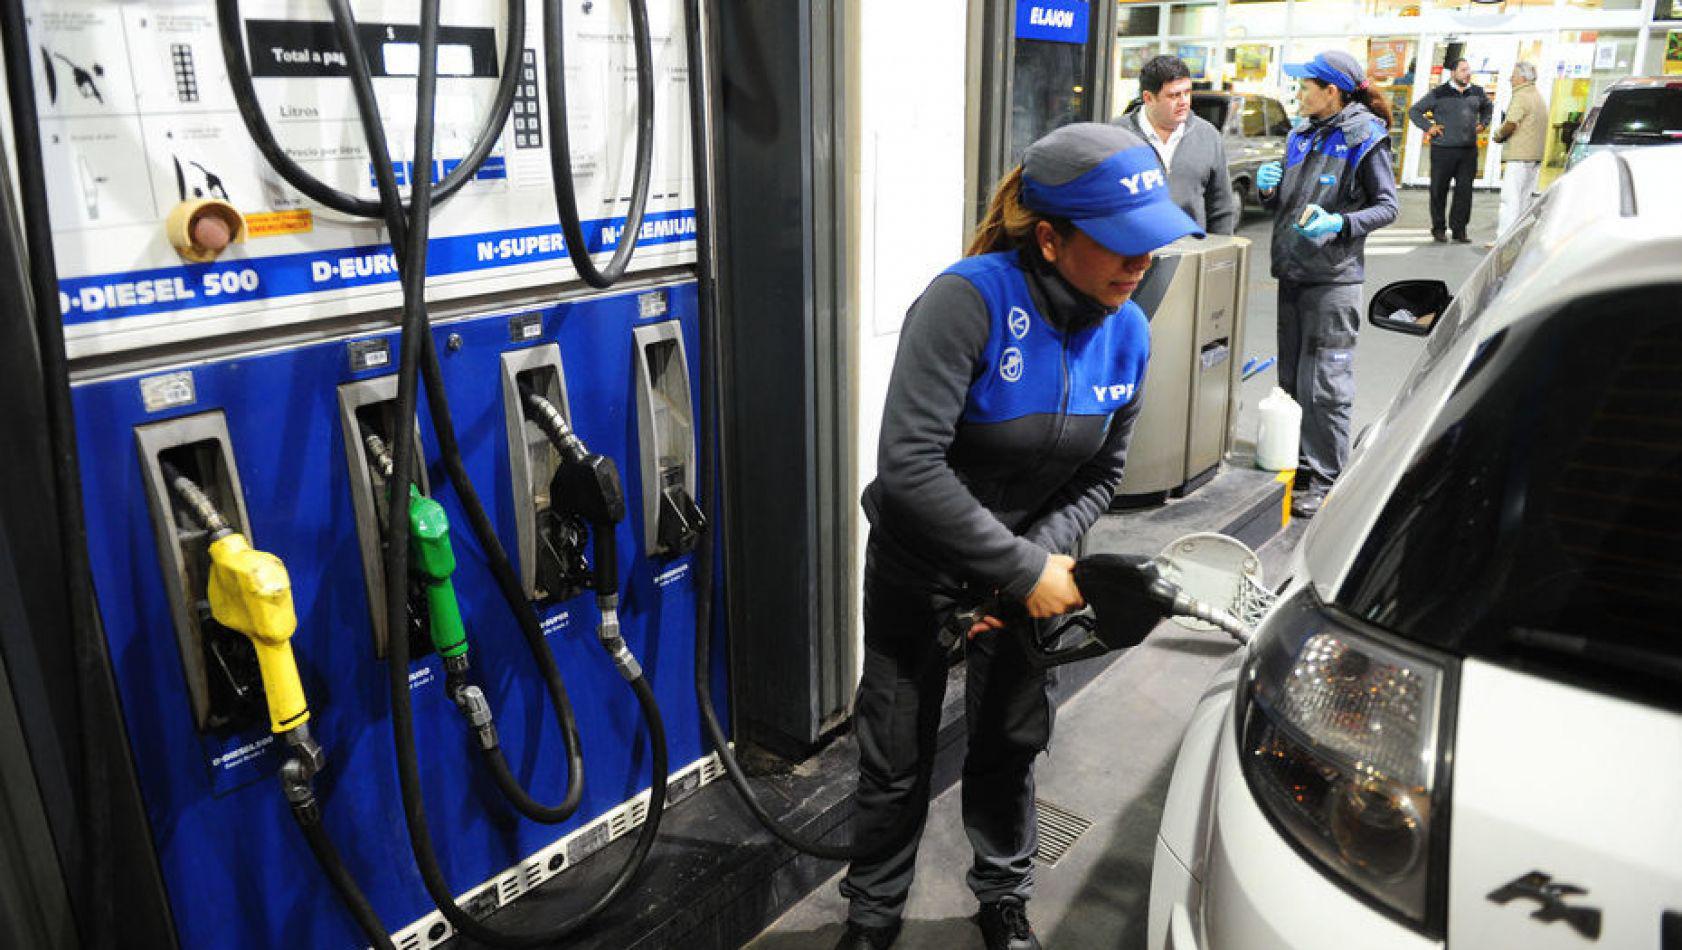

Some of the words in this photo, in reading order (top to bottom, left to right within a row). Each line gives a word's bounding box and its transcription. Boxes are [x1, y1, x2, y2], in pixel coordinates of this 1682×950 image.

[1030, 6, 1074, 28] ELAION
[271, 47, 309, 63] Total
[312, 51, 322, 63] a
[280, 104, 319, 117] Litros
[203, 269, 259, 297] 500
